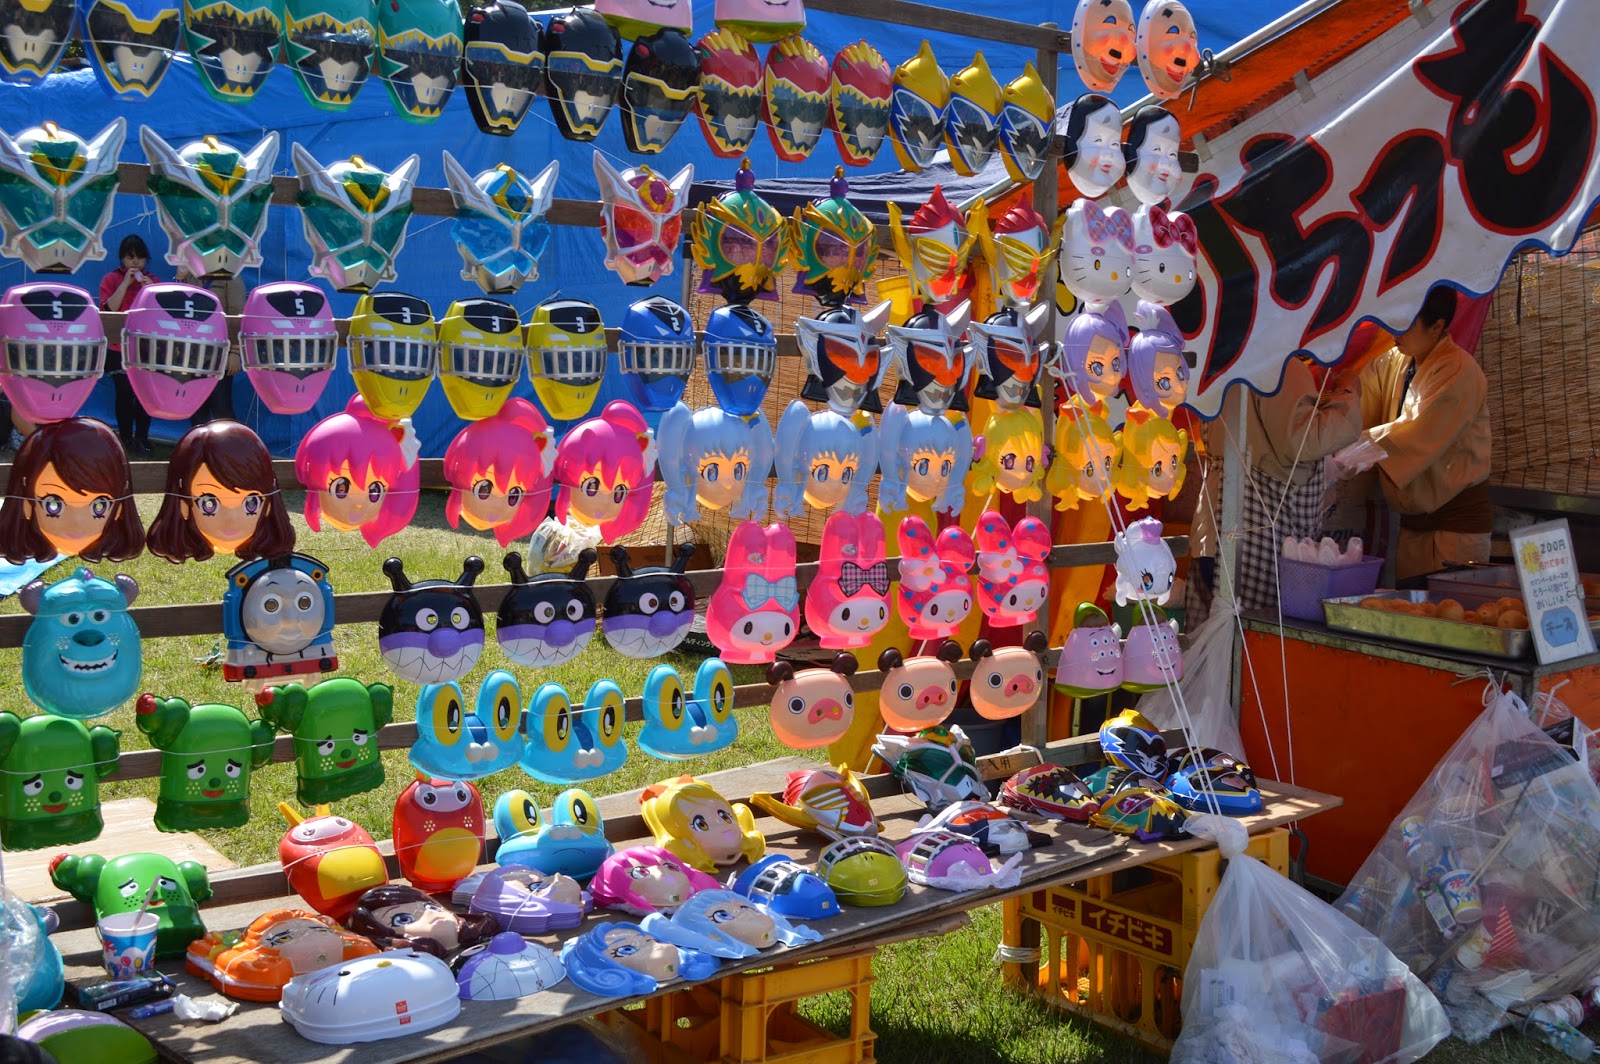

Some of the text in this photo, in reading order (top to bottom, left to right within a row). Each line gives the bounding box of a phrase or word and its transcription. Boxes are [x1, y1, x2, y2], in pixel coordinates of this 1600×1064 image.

[52, 300, 63, 319] 5
[184, 300, 195, 318] 5
[294, 298, 305, 315] 5
[402, 306, 411, 324] 3
[491, 315, 500, 332] 3
[575, 316, 585, 332] 3
[670, 316, 680, 332] 2
[753, 319, 763, 333] 2
[1540, 538, 1565, 554] 200円
[1052, 905, 1076, 920] イチビキ
[1088, 908, 1164, 950] イチビキ
